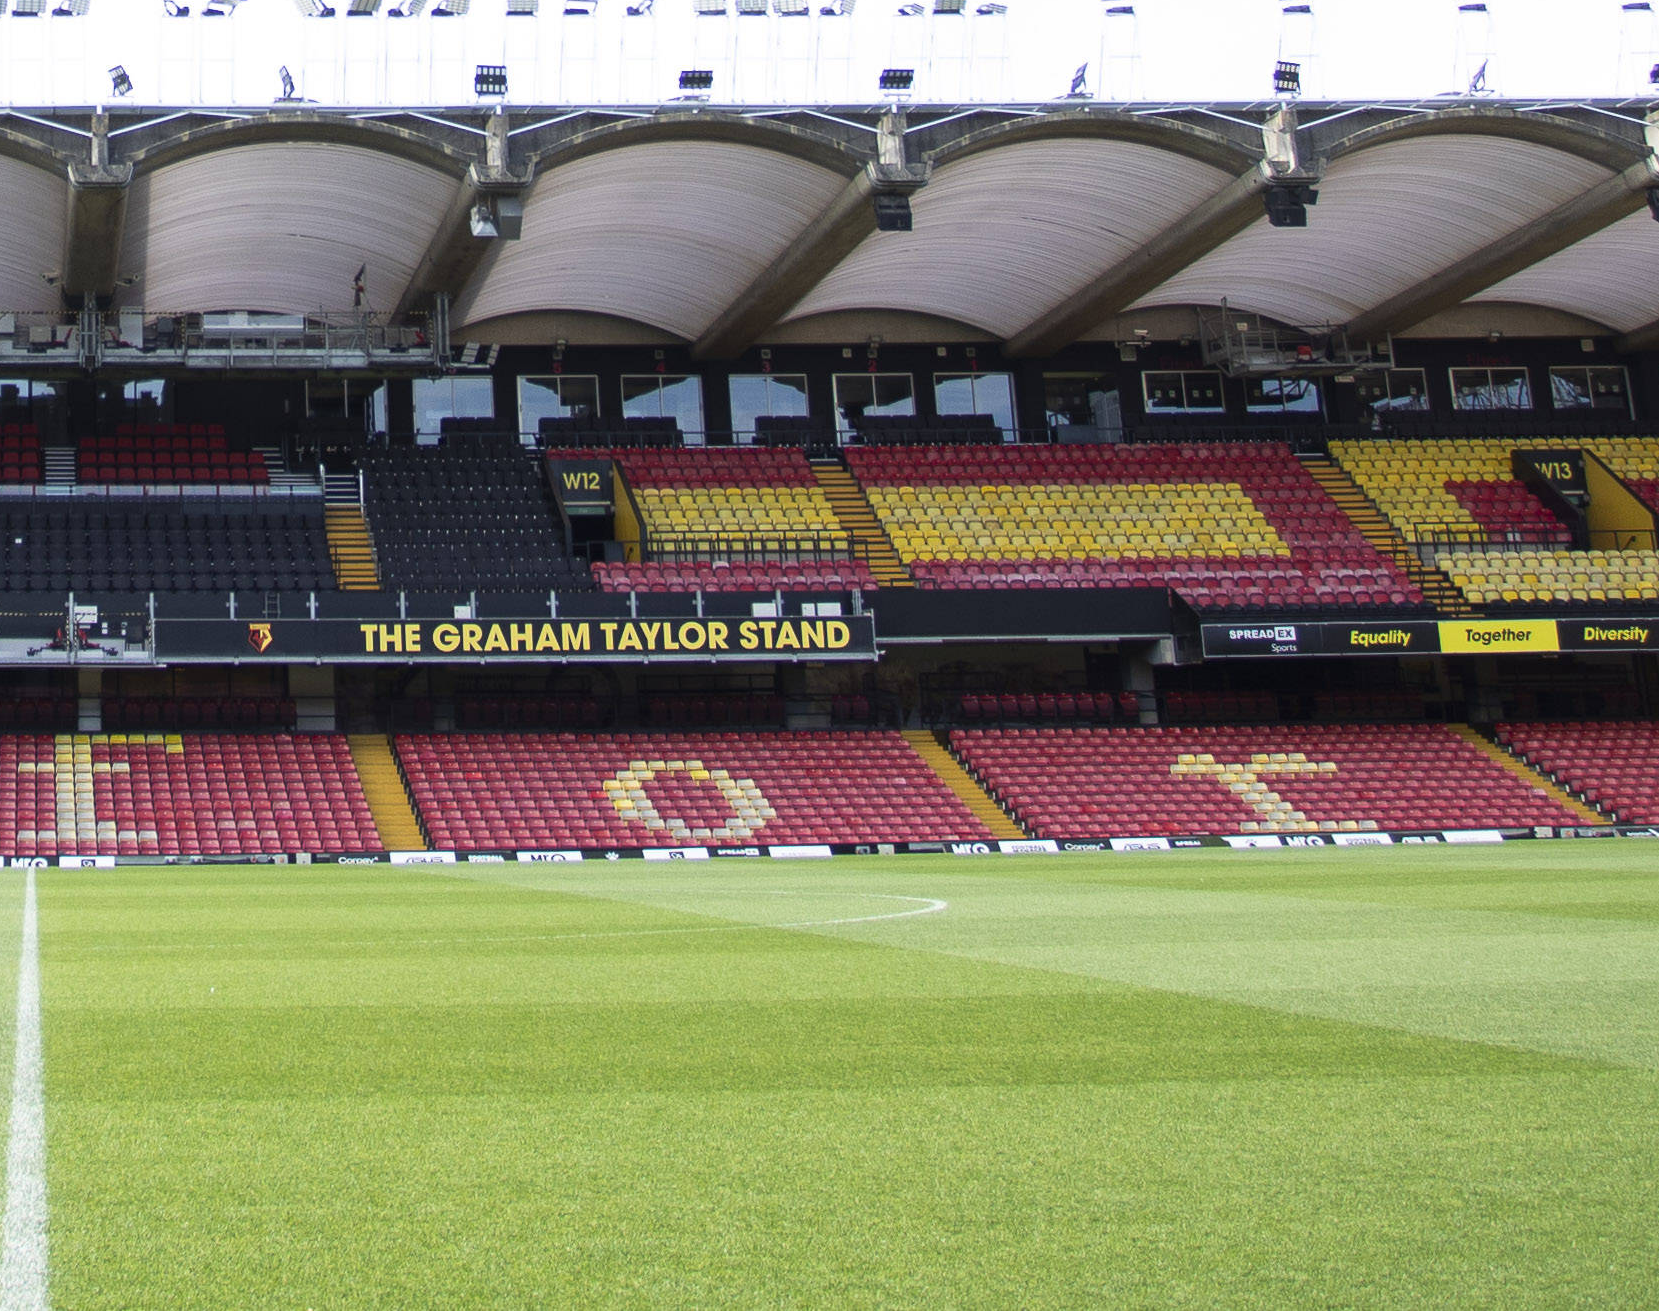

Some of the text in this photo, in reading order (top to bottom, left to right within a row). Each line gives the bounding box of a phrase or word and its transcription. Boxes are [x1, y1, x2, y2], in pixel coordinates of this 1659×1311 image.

[562, 472, 601, 490] W12
[360, 620, 850, 652] THE GRAHAM TAYLOR STAND
[1350, 629, 1411, 646] Equality
[1465, 627, 1532, 646] Together
[1583, 626, 1649, 644] Diversity
[1271, 643, 1297, 653] Sports
